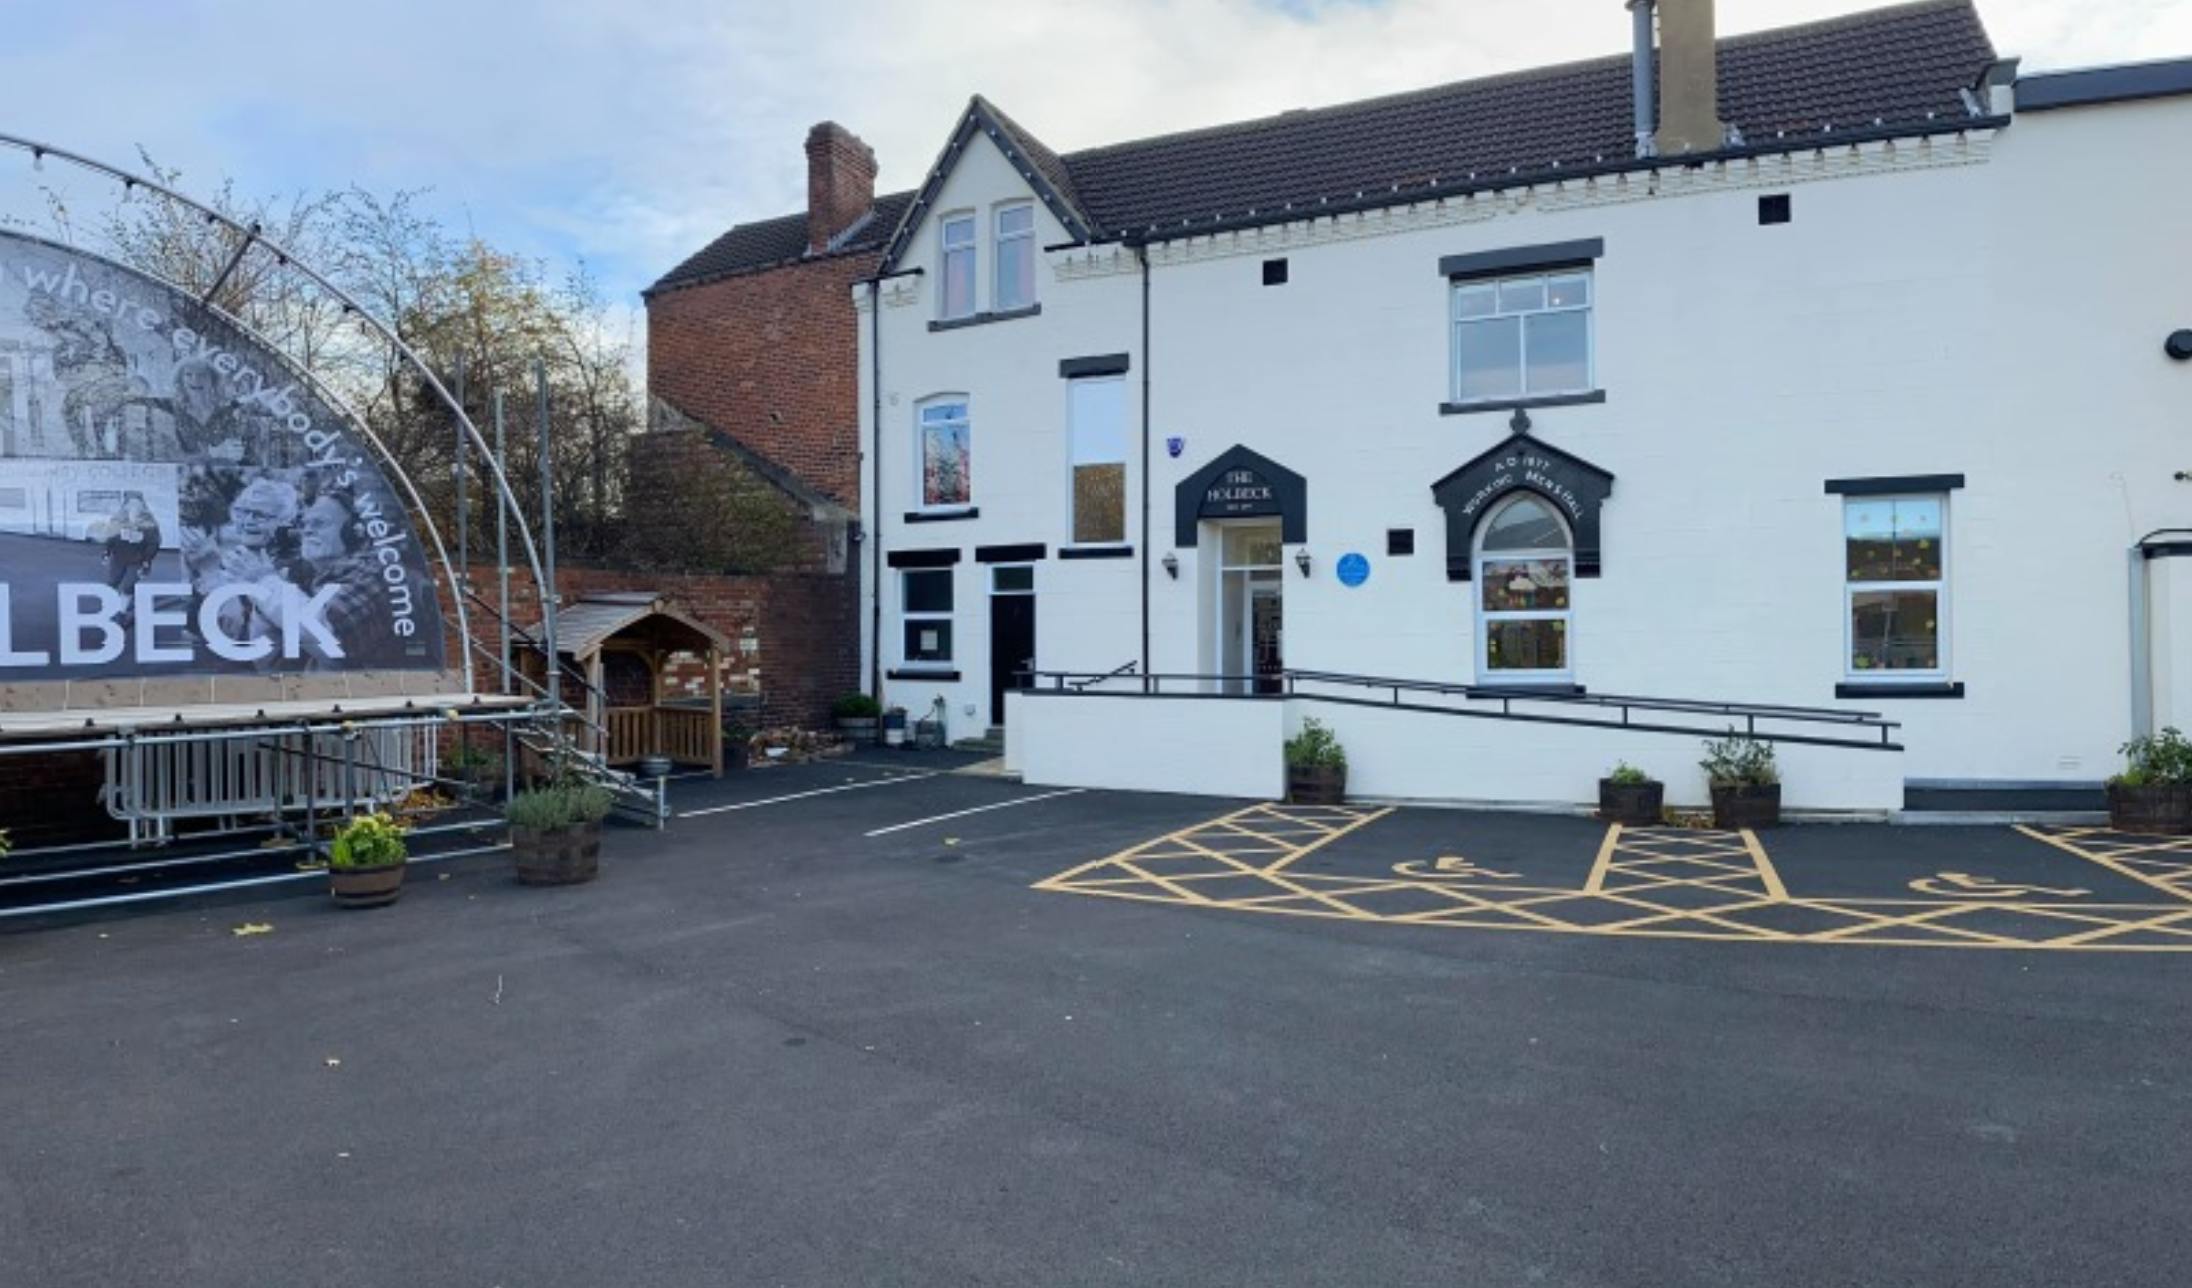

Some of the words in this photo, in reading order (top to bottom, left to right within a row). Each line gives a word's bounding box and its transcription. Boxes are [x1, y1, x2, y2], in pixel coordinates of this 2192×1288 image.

[25, 262, 162, 331] where
[172, 327, 363, 486] everybody's
[353, 492, 416, 638] welcome
[1226, 470, 1253, 484] THE
[1207, 486, 1272, 502] HOLBECK
[1462, 473, 1513, 515] WORKING
